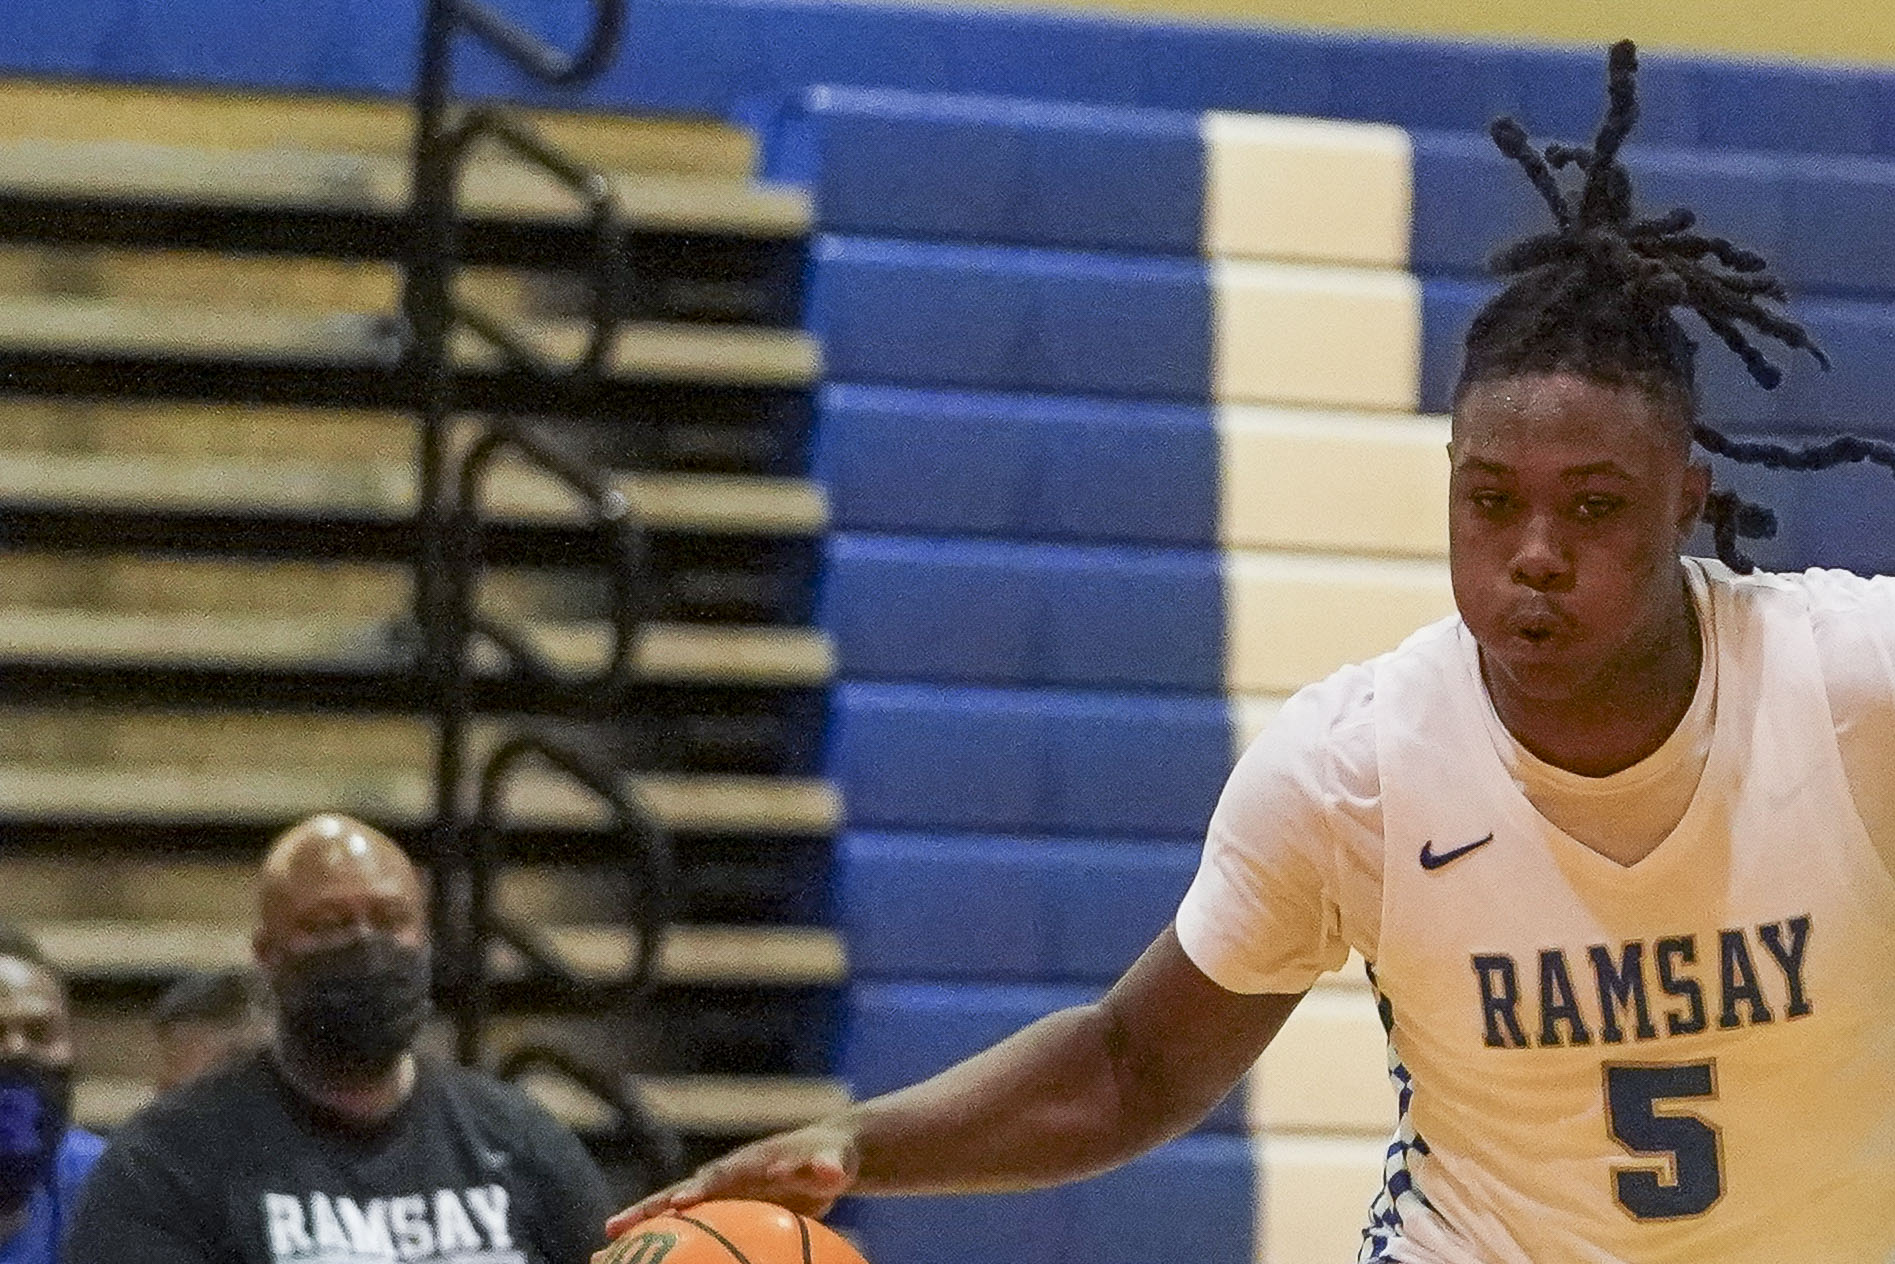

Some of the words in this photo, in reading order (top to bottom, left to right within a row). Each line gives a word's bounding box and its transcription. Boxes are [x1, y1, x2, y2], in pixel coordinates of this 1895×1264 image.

[1470, 912, 1815, 1049] RAMSAY
[1601, 1056, 1728, 1223] 5
[264, 1183, 514, 1258] RAMSAY
